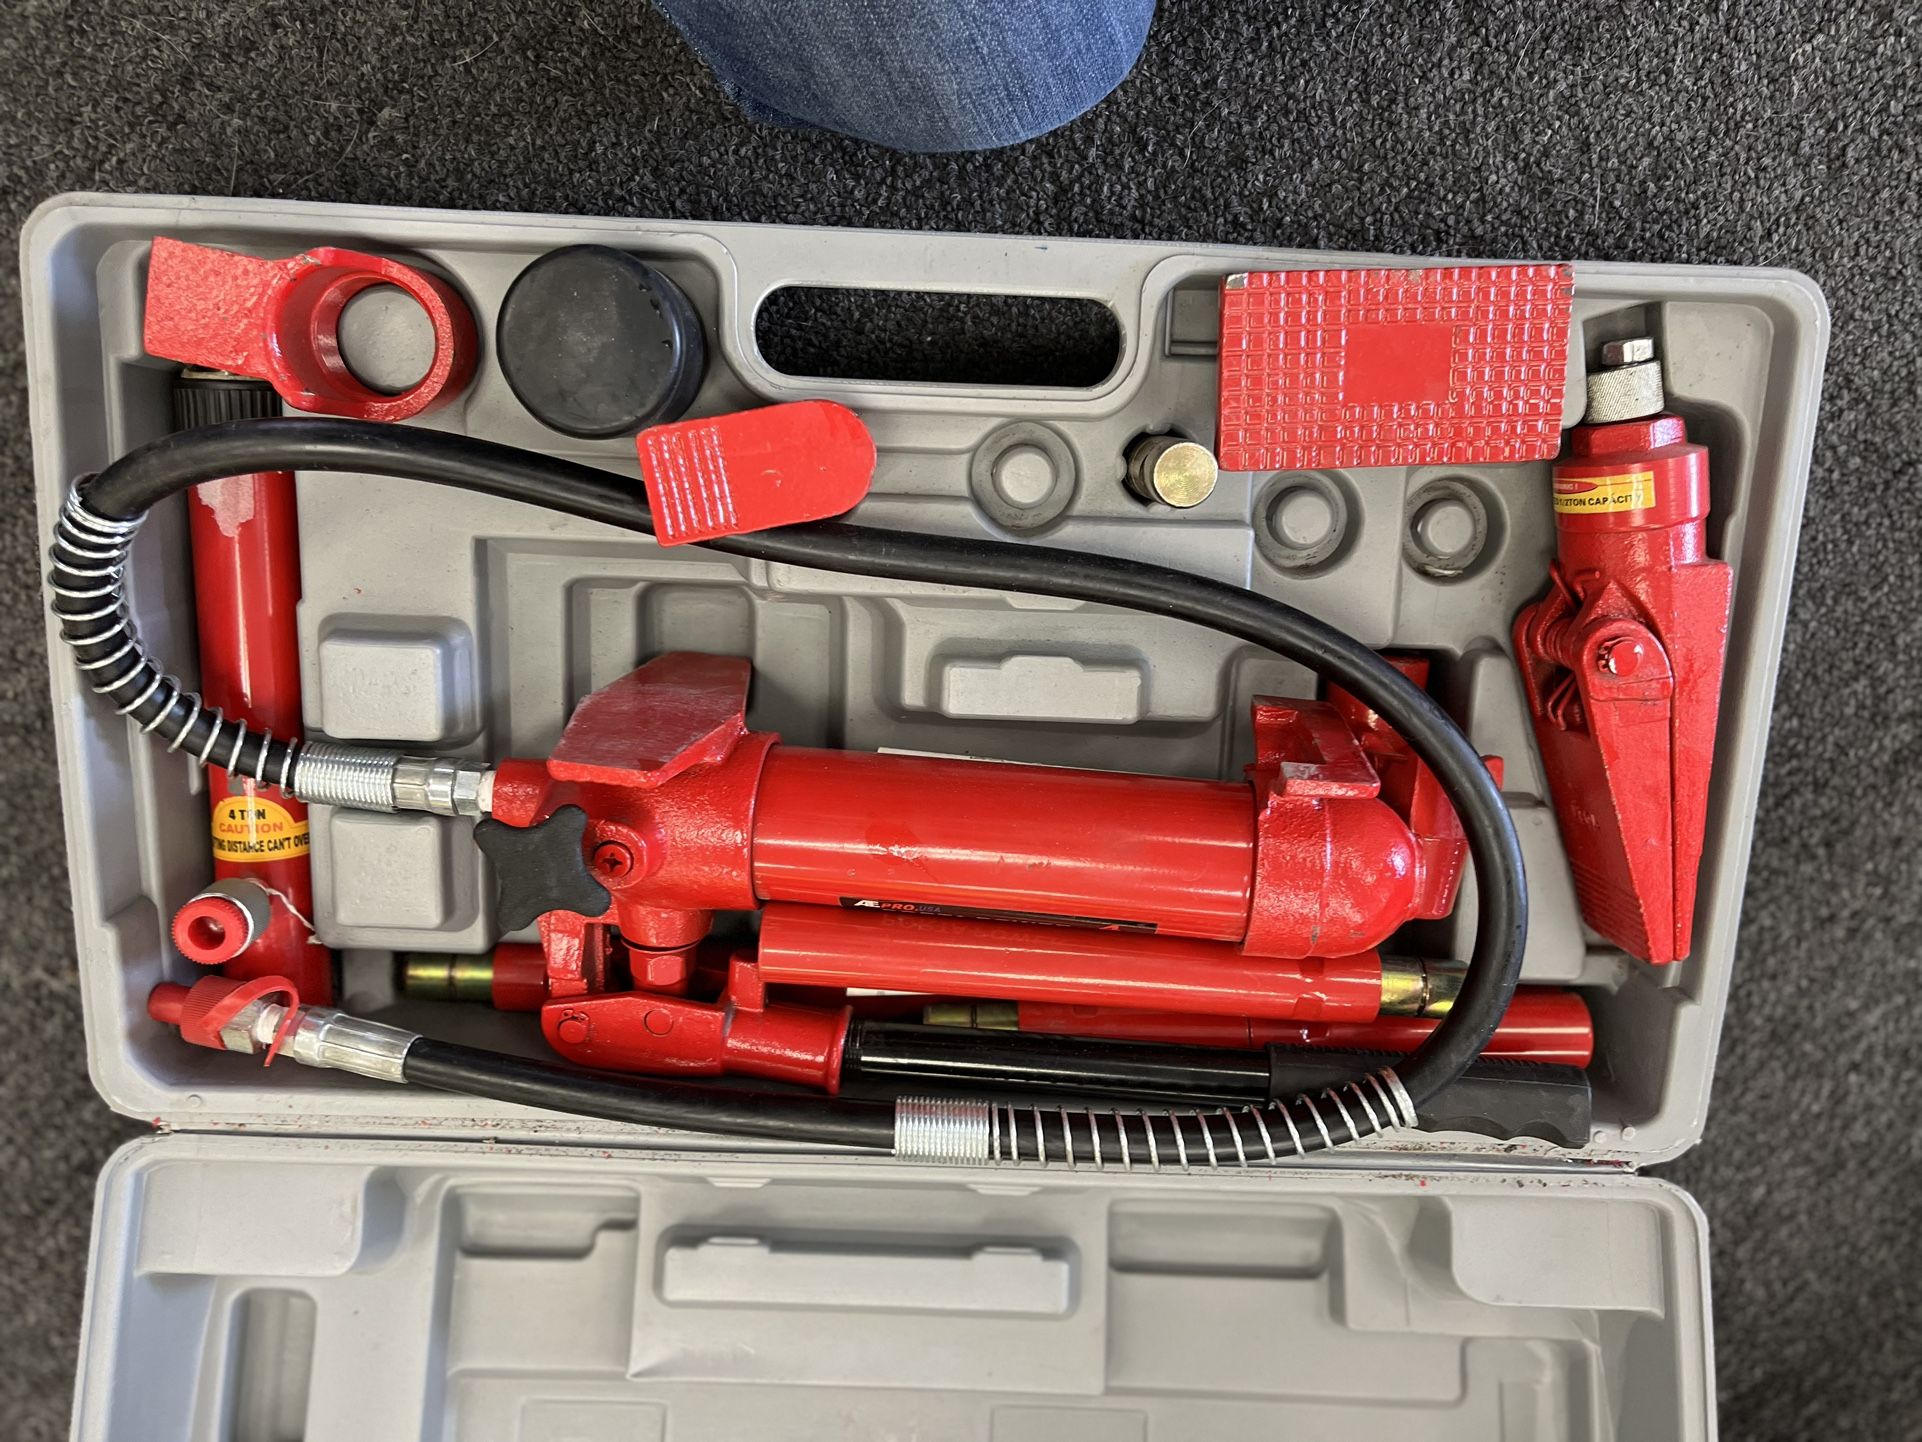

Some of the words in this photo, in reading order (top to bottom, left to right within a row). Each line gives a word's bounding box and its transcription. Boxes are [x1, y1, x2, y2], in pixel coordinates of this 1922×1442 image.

[1588, 494, 1641, 506] CAPACITY
[228, 809, 236, 820] 4
[219, 822, 283, 834] CAUTION
[227, 839, 265, 853] DISTANCE
[267, 836, 292, 851] CAN'T
